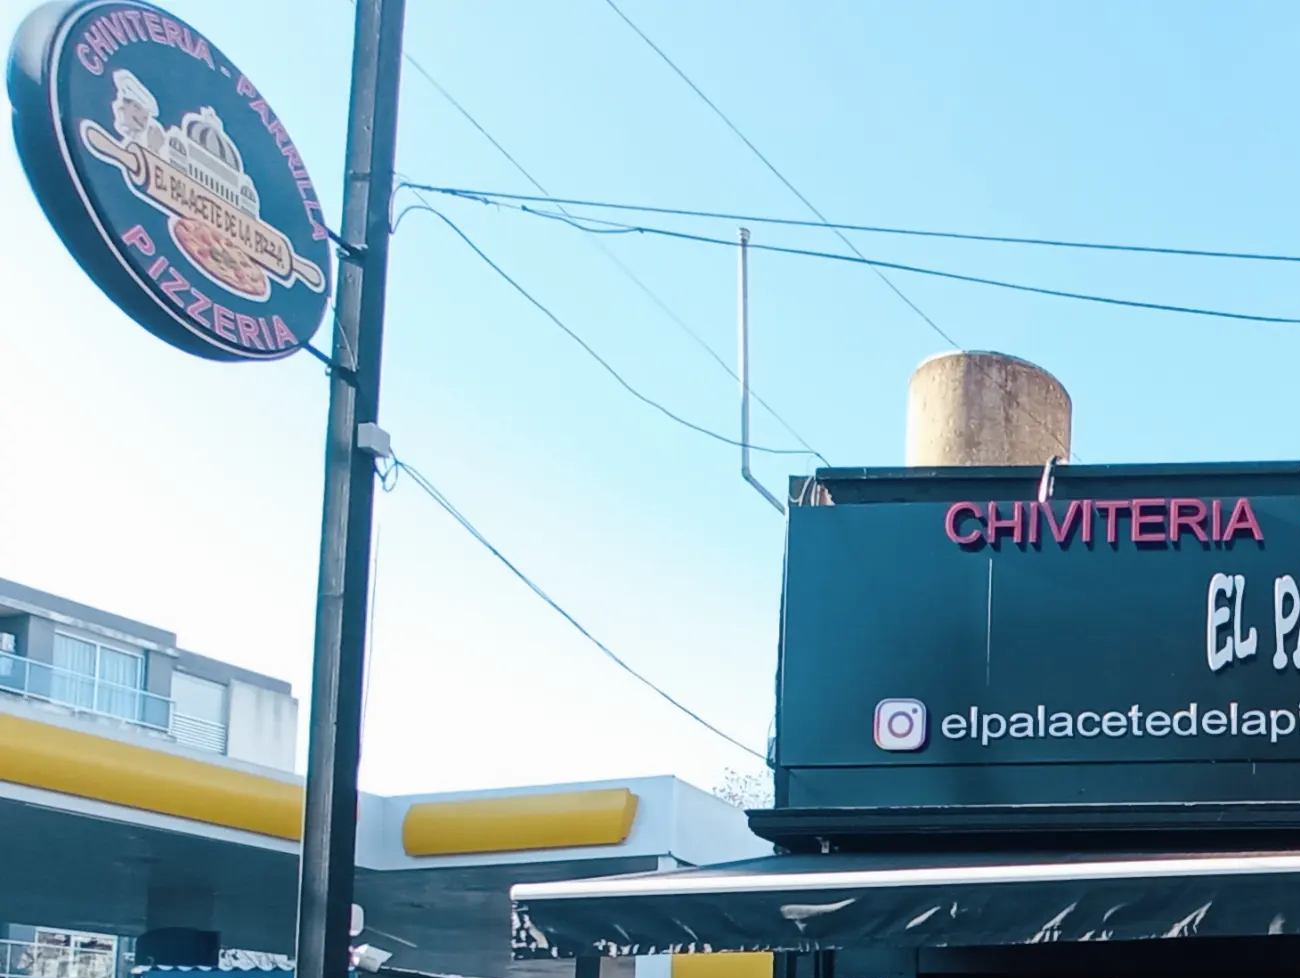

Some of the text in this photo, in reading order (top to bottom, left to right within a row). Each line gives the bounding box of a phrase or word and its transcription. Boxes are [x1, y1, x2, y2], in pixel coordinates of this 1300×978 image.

[76, 10, 216, 76] CHIVITERIA
[237, 79, 329, 241] PARRILLA
[154, 165, 167, 191] EL
[224, 210, 237, 237] DE
[121, 224, 298, 351] PIZZERIA
[944, 498, 1264, 547] CHIVITERIA
[1206, 572, 1258, 673] EL
